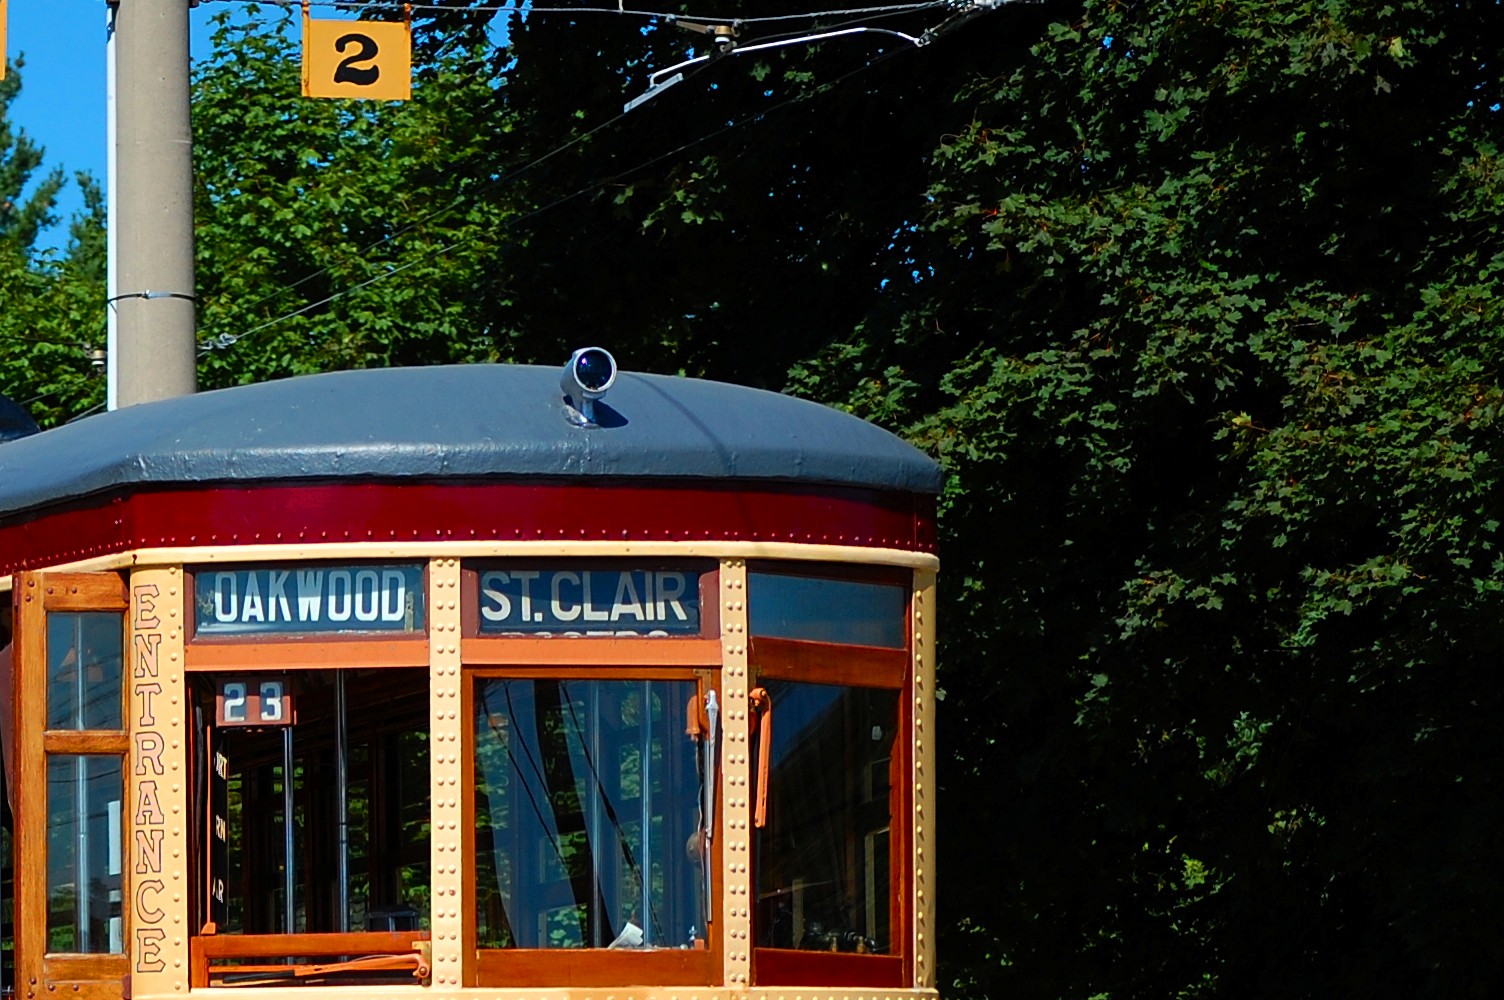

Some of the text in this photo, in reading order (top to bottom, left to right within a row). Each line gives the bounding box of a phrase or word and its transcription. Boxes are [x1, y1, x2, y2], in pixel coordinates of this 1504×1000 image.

[333, 33, 380, 86] 2
[214, 569, 406, 623] OAKWOOD
[550, 570, 688, 622] CLAIR
[134, 583, 167, 974] ENTRANCE
